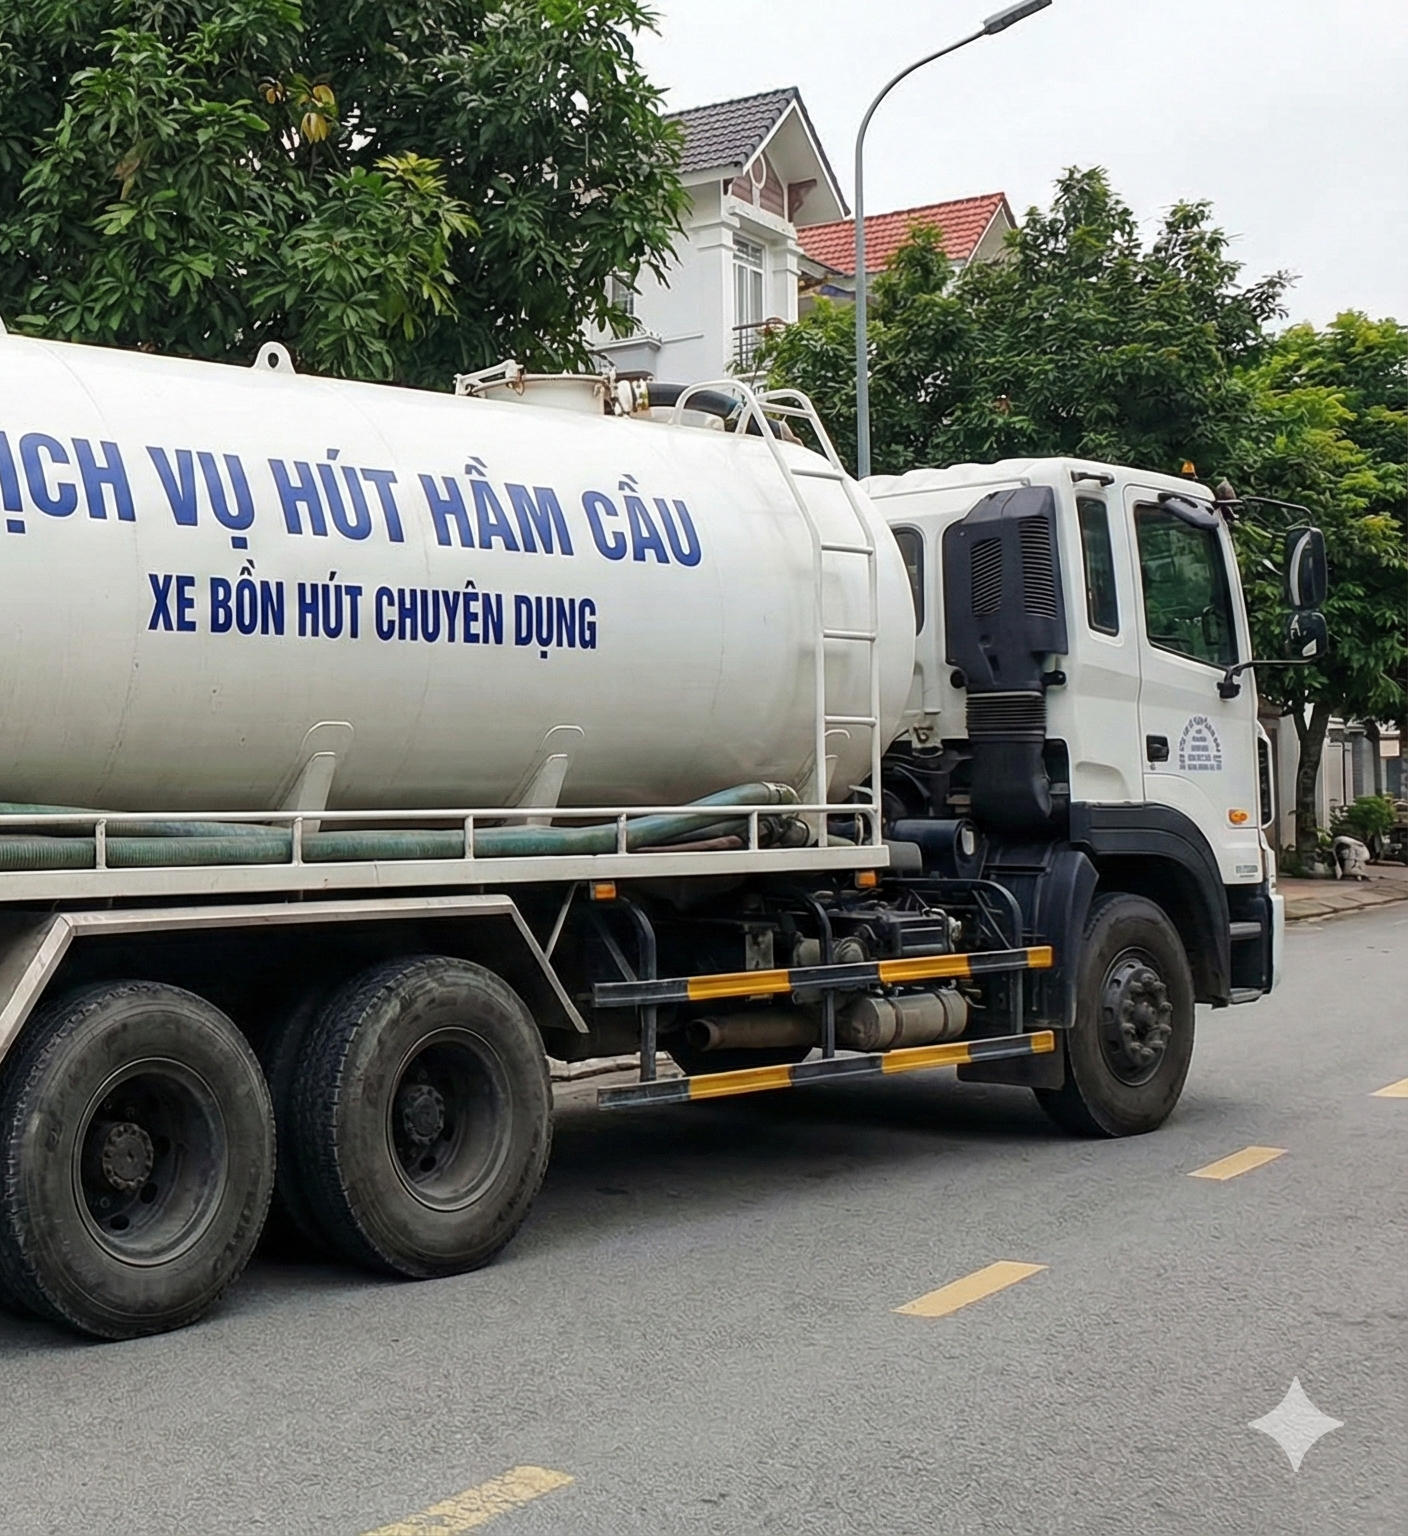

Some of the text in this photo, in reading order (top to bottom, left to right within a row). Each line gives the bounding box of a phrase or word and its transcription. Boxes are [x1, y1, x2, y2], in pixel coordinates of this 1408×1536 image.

[145, 446, 256, 550] VỤ
[268, 447, 405, 543] HÚT
[418, 455, 575, 557] HẦM
[580, 473, 703, 567] CẦU
[147, 558, 597, 660] XE BỒN HÚT CHUYÊN DỤNG
